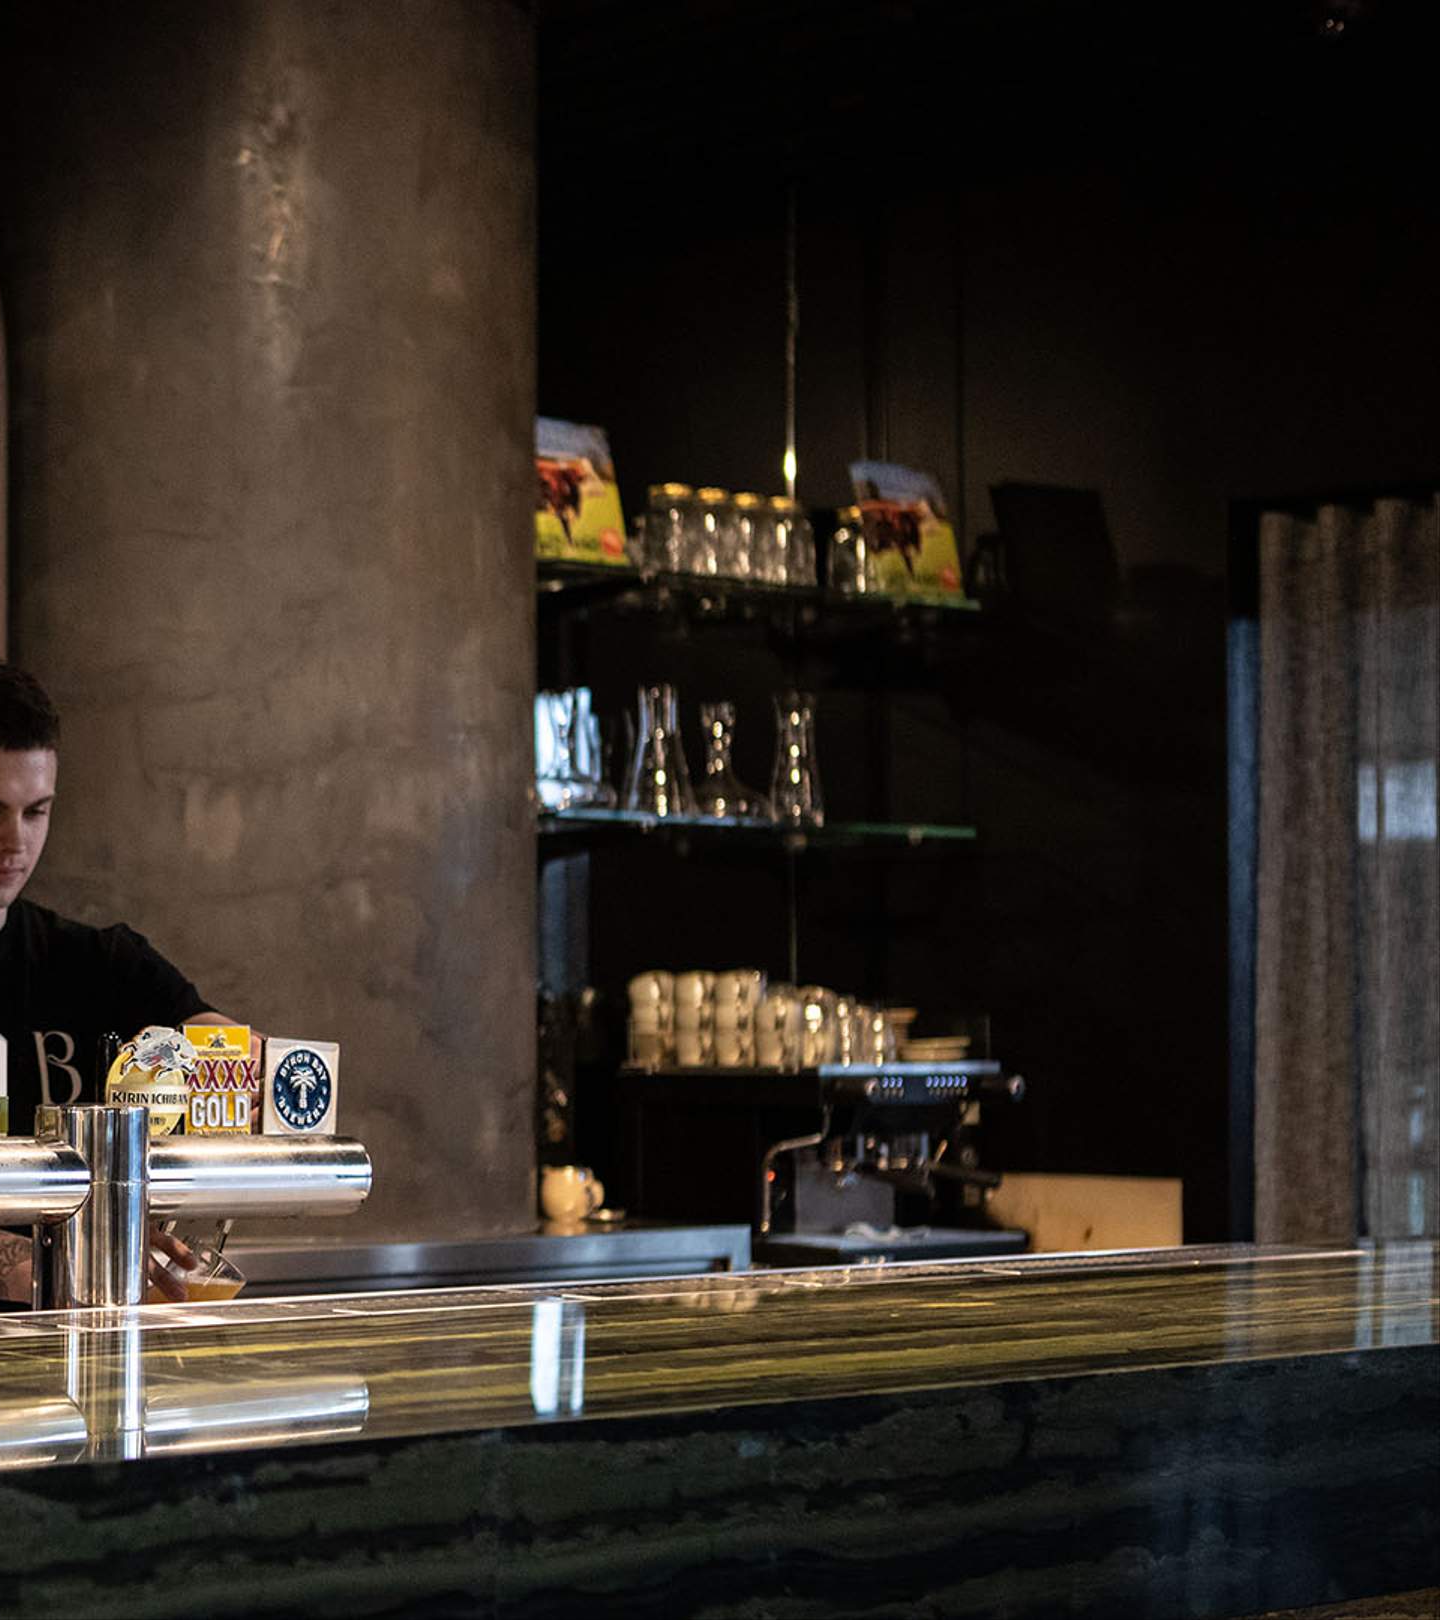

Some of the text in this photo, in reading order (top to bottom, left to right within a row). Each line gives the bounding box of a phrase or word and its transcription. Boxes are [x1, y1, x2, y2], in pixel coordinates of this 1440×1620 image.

[188, 1058, 259, 1092] XXXX
[279, 1052, 328, 1081] BYRON BAY
[112, 1091, 149, 1104] KIRIN
[191, 1094, 250, 1128] GOLD
[278, 1096, 325, 1125] BREWERY
